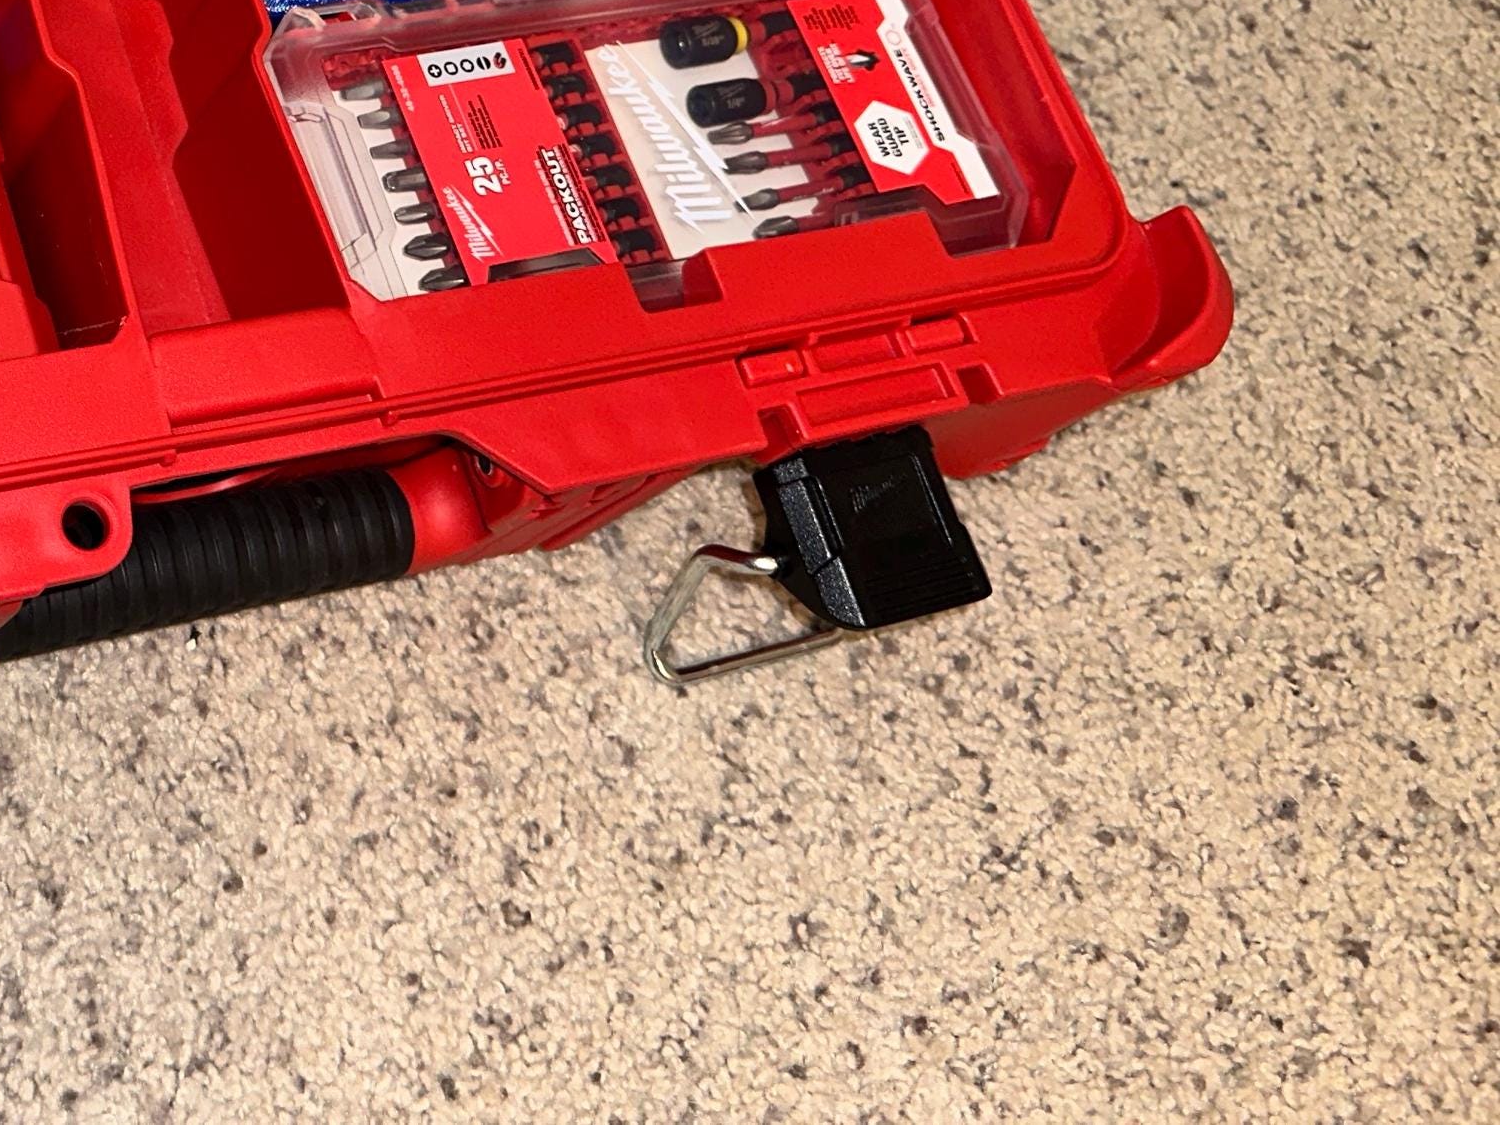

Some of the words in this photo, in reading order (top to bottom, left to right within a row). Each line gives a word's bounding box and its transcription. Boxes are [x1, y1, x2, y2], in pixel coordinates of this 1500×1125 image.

[893, 49, 946, 142] SHOCKWAVE
[597, 42, 732, 235] Milwaukee
[867, 122, 890, 157] WEAR
[877, 118, 903, 157] GUARD
[893, 126, 909, 145] TIP
[465, 156, 504, 196] 25
[541, 148, 593, 245] PACKOUT
[442, 186, 496, 263] Milwaukee
